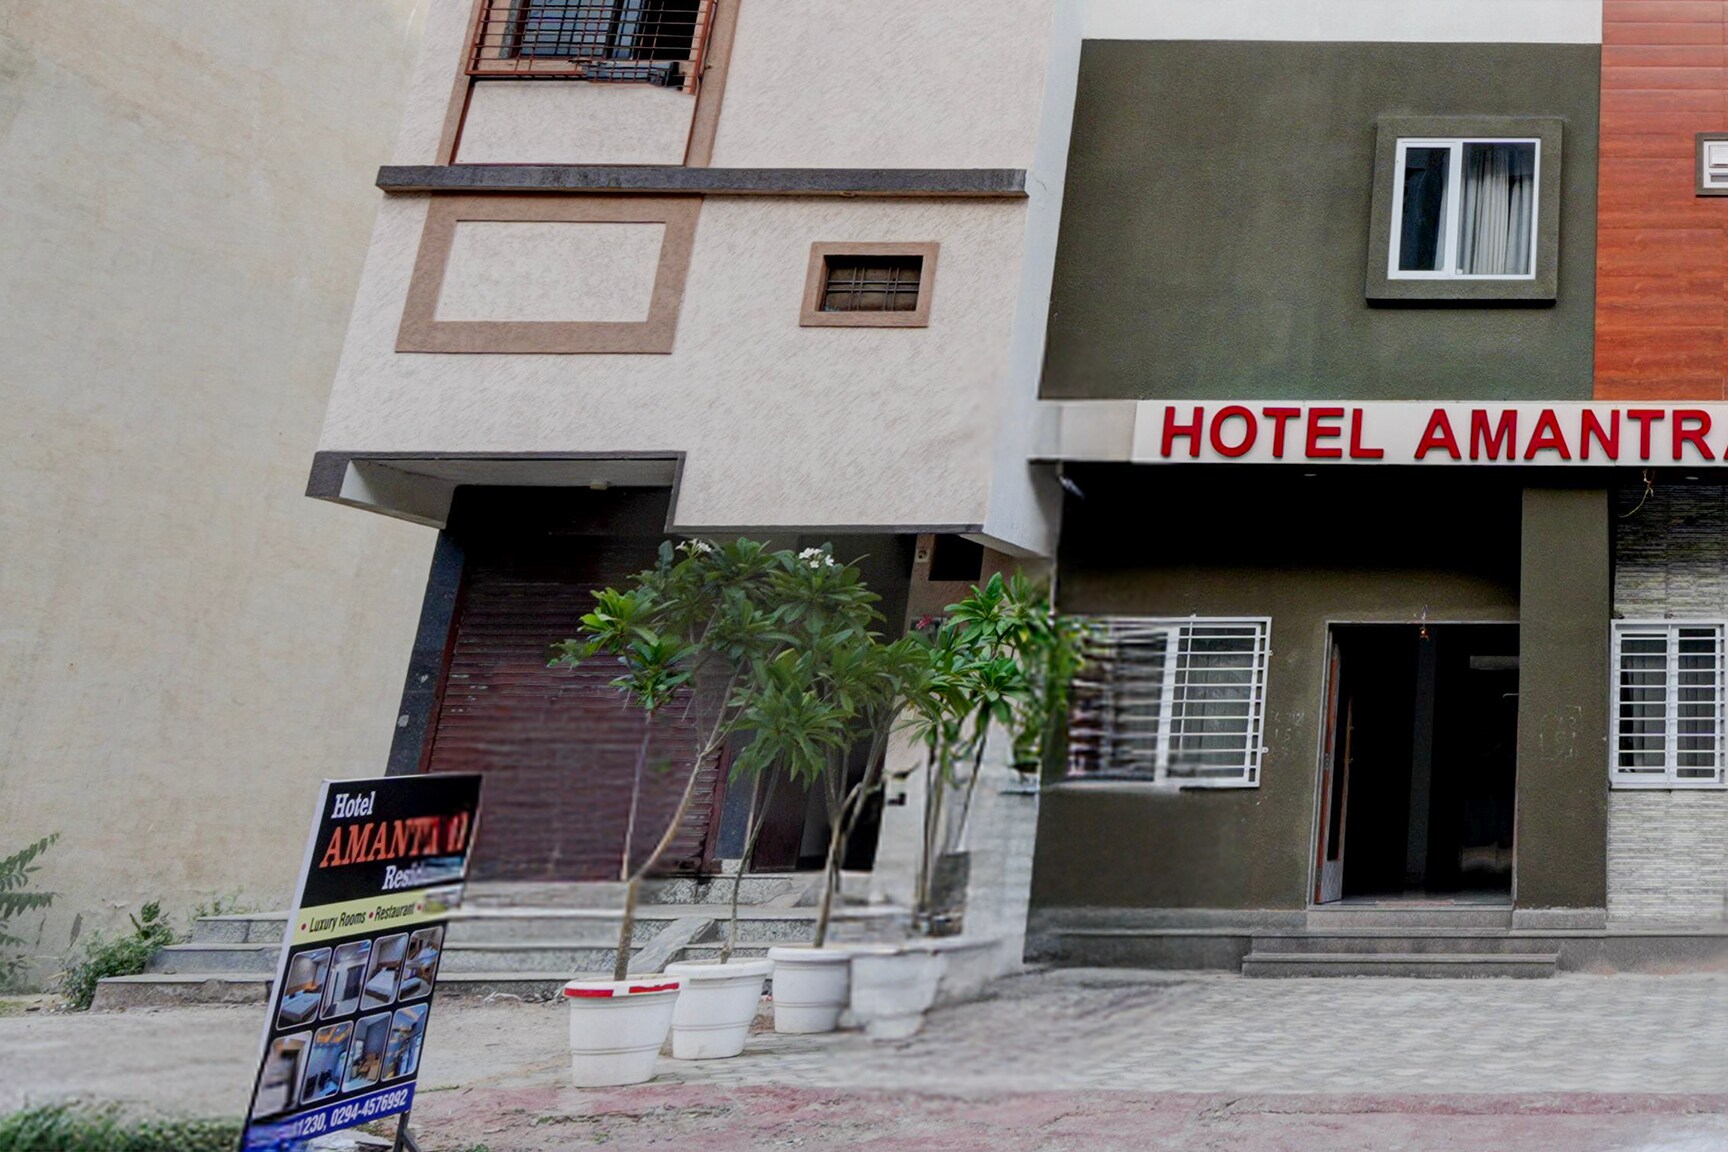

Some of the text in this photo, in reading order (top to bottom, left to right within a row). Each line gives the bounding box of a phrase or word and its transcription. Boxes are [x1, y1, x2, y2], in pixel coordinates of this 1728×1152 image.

[1161, 405, 1385, 459] HOTEL
[331, 791, 375, 819] Hotel
[308, 903, 416, 933] Luxury Rooms Restaurant
